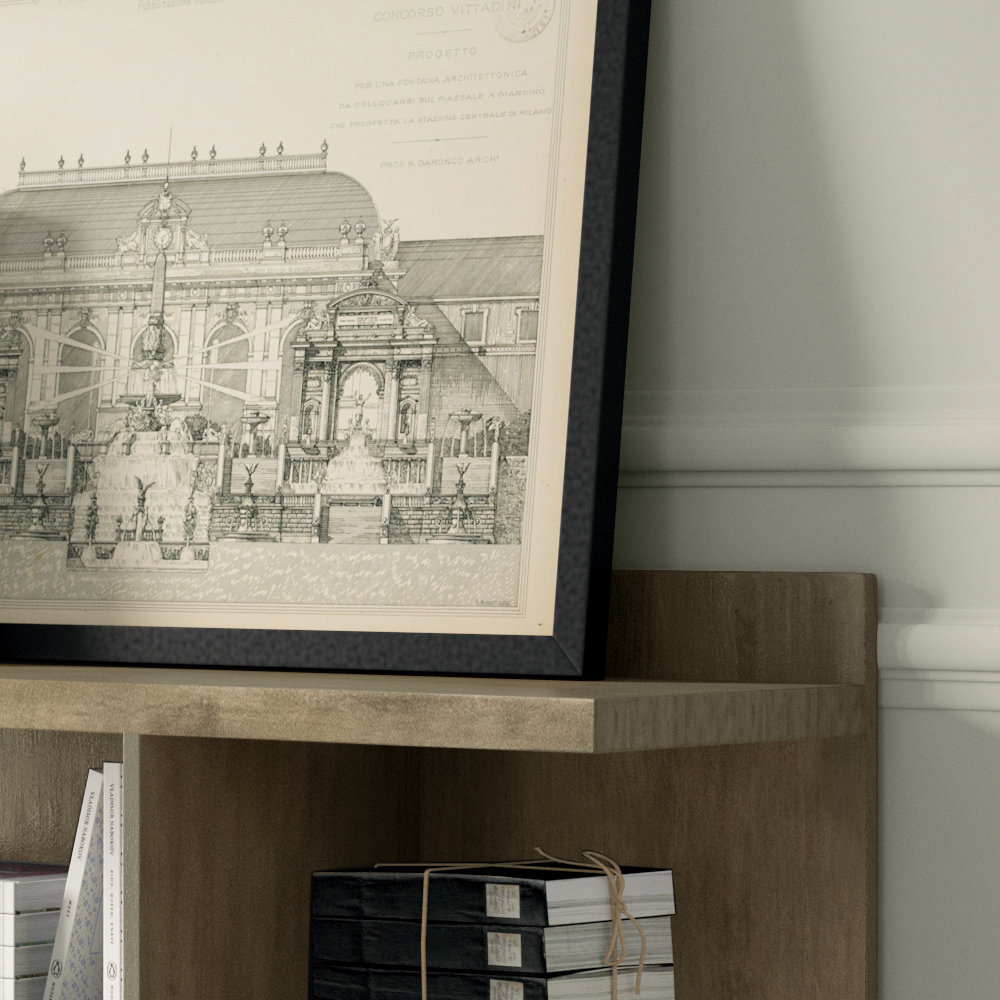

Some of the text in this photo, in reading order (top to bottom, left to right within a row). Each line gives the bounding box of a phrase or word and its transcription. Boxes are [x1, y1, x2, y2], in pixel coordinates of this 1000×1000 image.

[373, 6, 445, 23] CONCORSO
[408, 46, 478, 61] PROGETTO
[354, 80, 372, 89] PER
[375, 79, 395, 88] UNA
[443, 69, 529, 84] ARCHITETTONICA
[519, 106, 553, 117] MILANO
[77, 791, 95, 861] VLADIMIR NABOKOV
